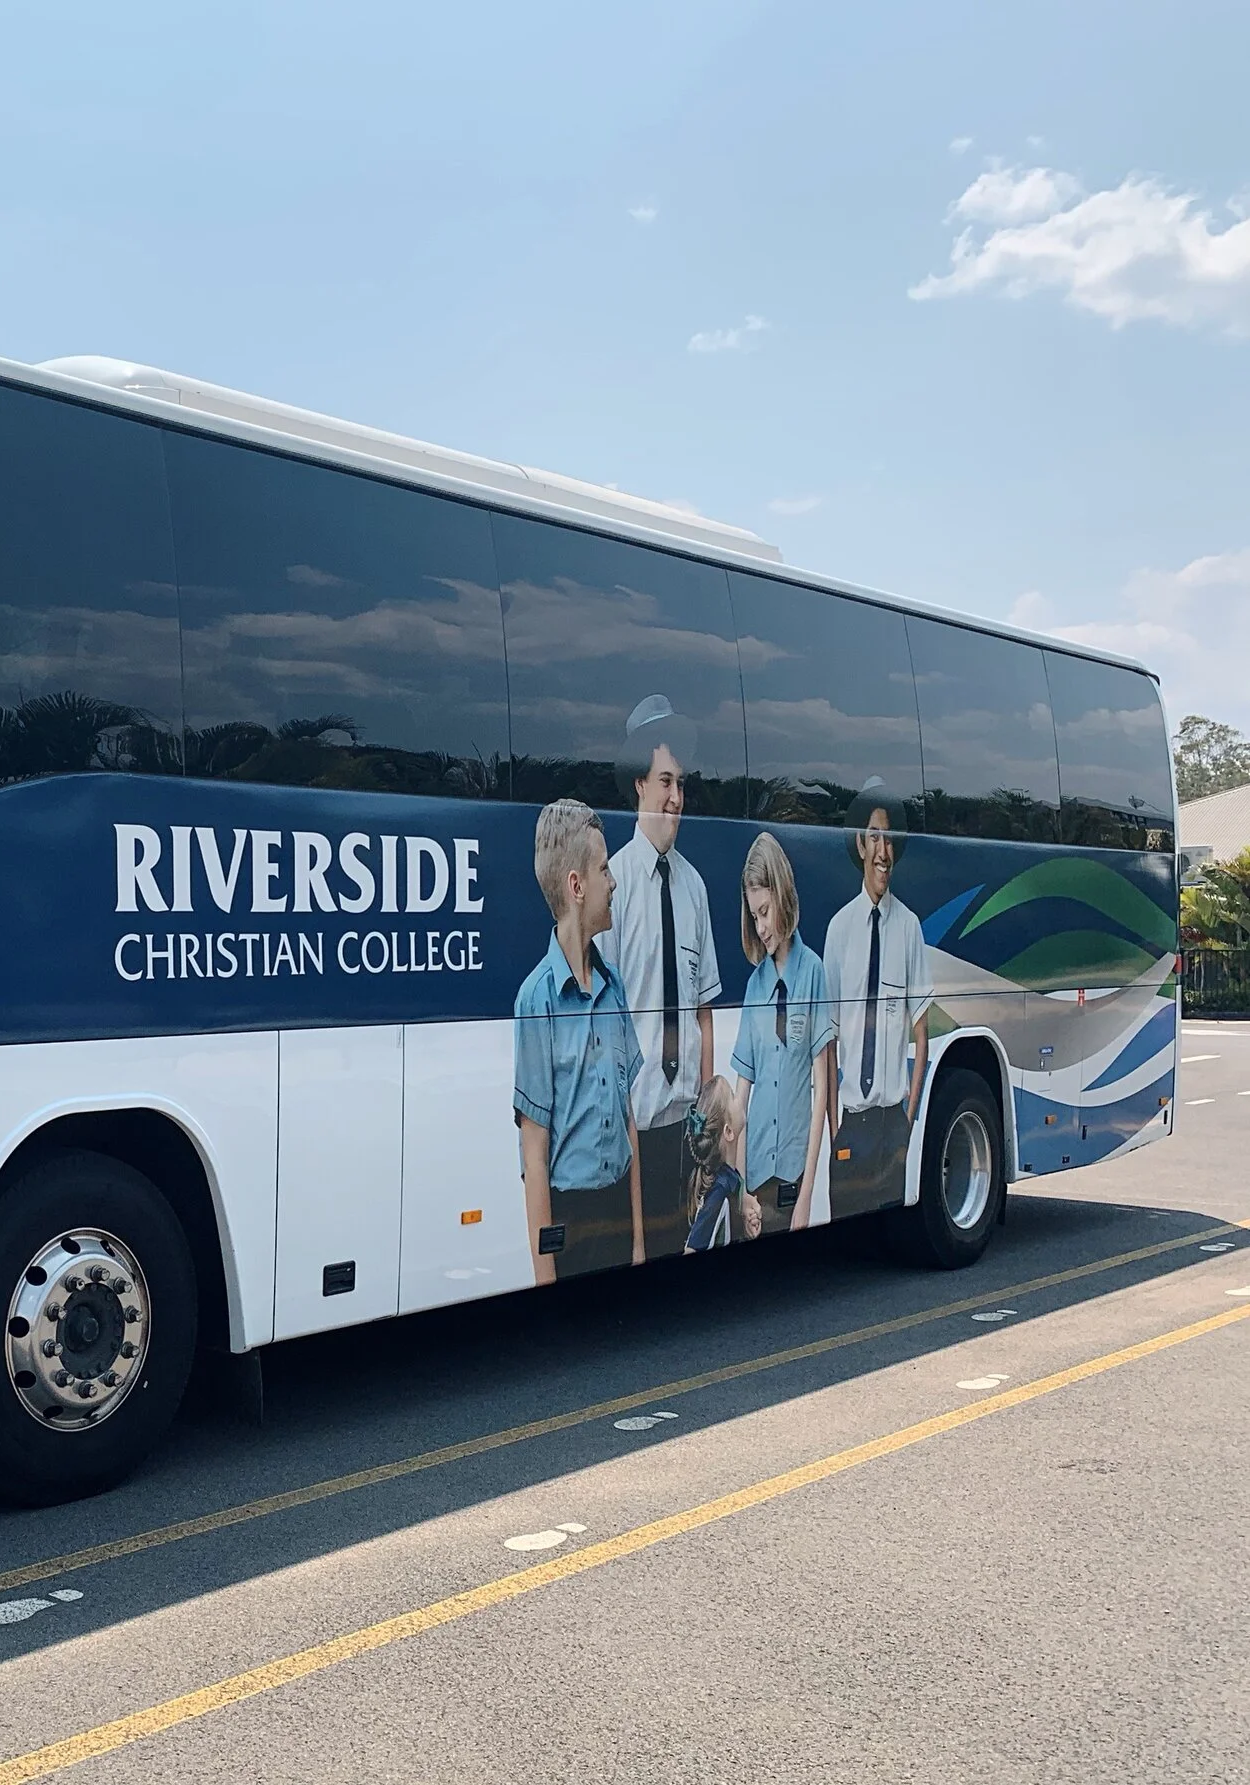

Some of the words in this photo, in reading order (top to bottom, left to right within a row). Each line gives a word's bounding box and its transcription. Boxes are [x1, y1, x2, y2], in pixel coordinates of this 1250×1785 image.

[113, 823, 484, 913] RIVERSIDE
[114, 932, 324, 981] CHRISTIAN
[337, 930, 483, 974] COLLEGE
